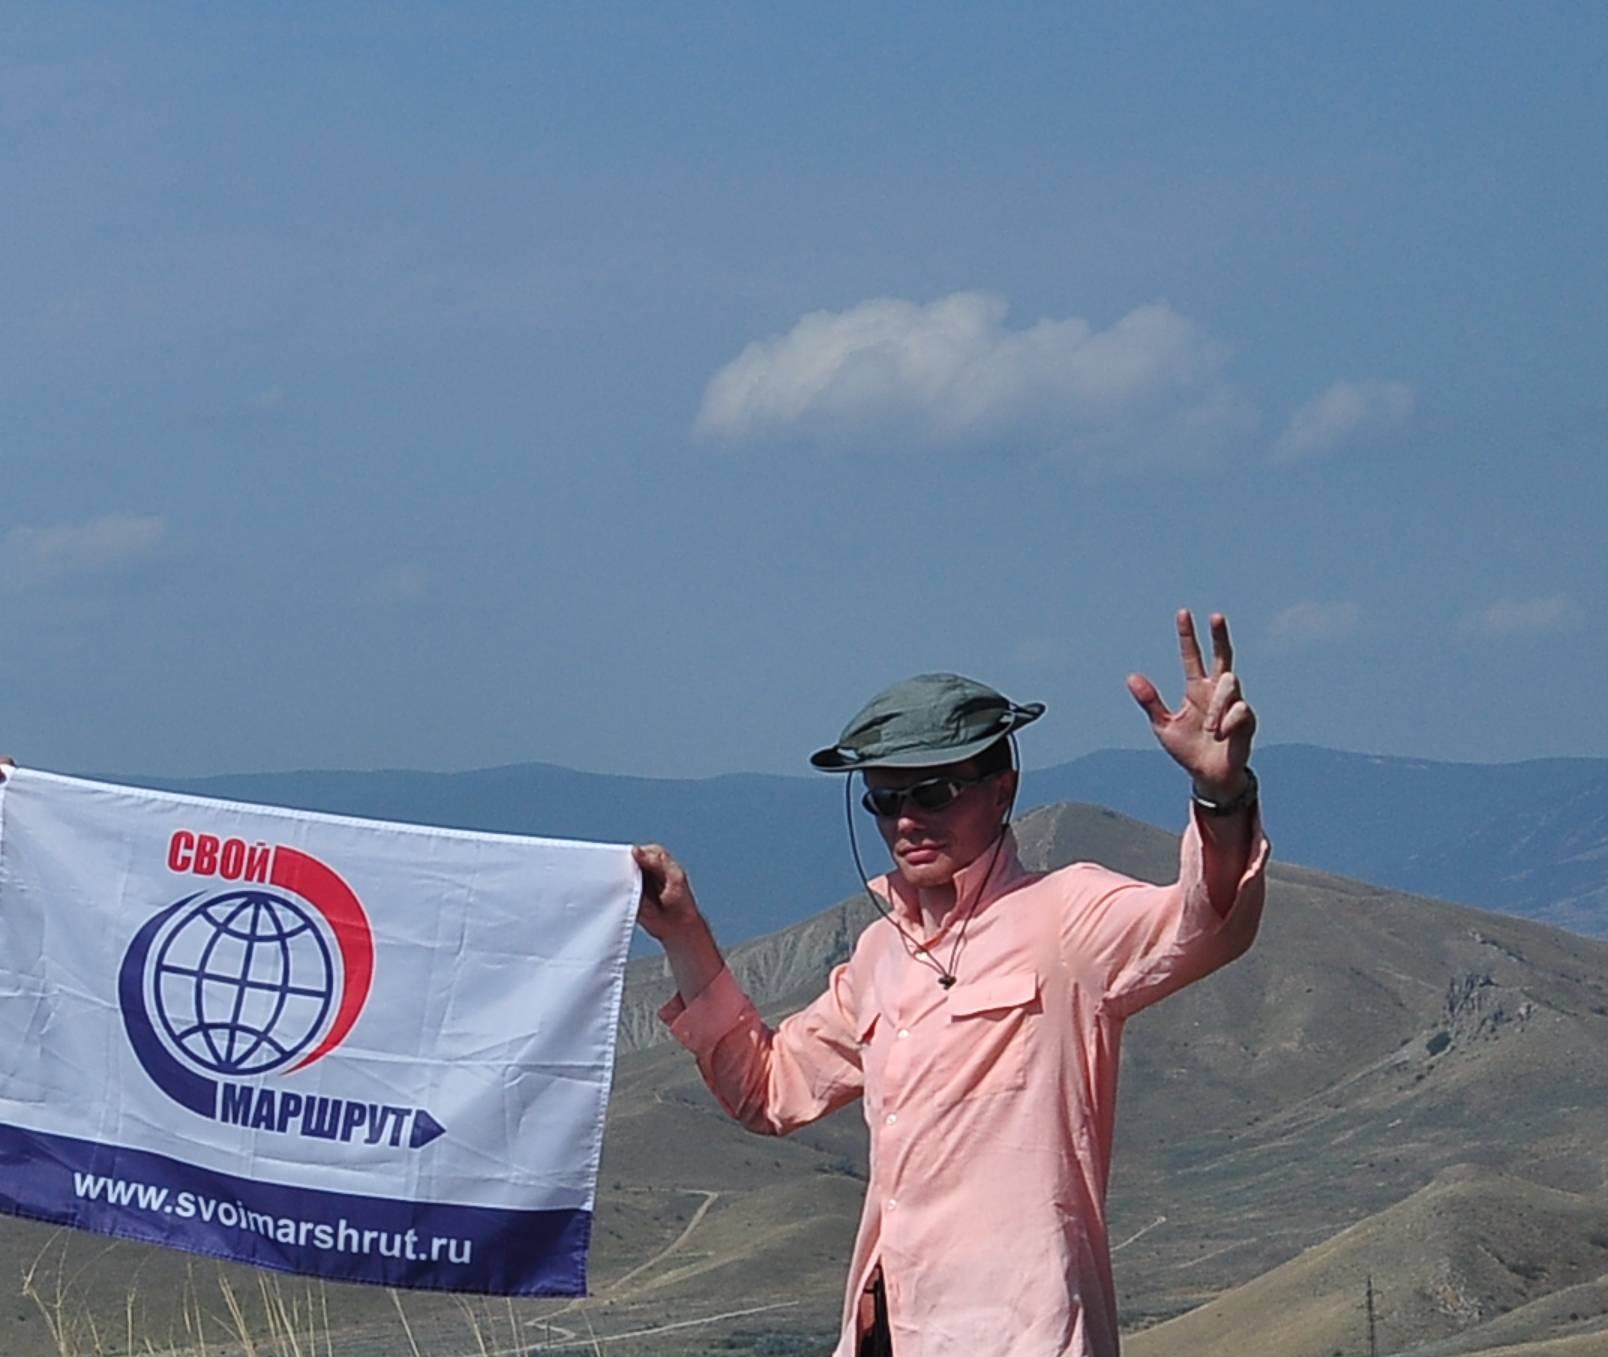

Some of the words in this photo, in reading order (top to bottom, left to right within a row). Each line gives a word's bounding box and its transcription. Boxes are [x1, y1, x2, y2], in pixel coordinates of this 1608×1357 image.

[168, 830, 270, 884] СВОЙ
[220, 1082, 412, 1147] МАРШРУТ
[73, 1171, 472, 1264] www.svoimarshrut.ru
